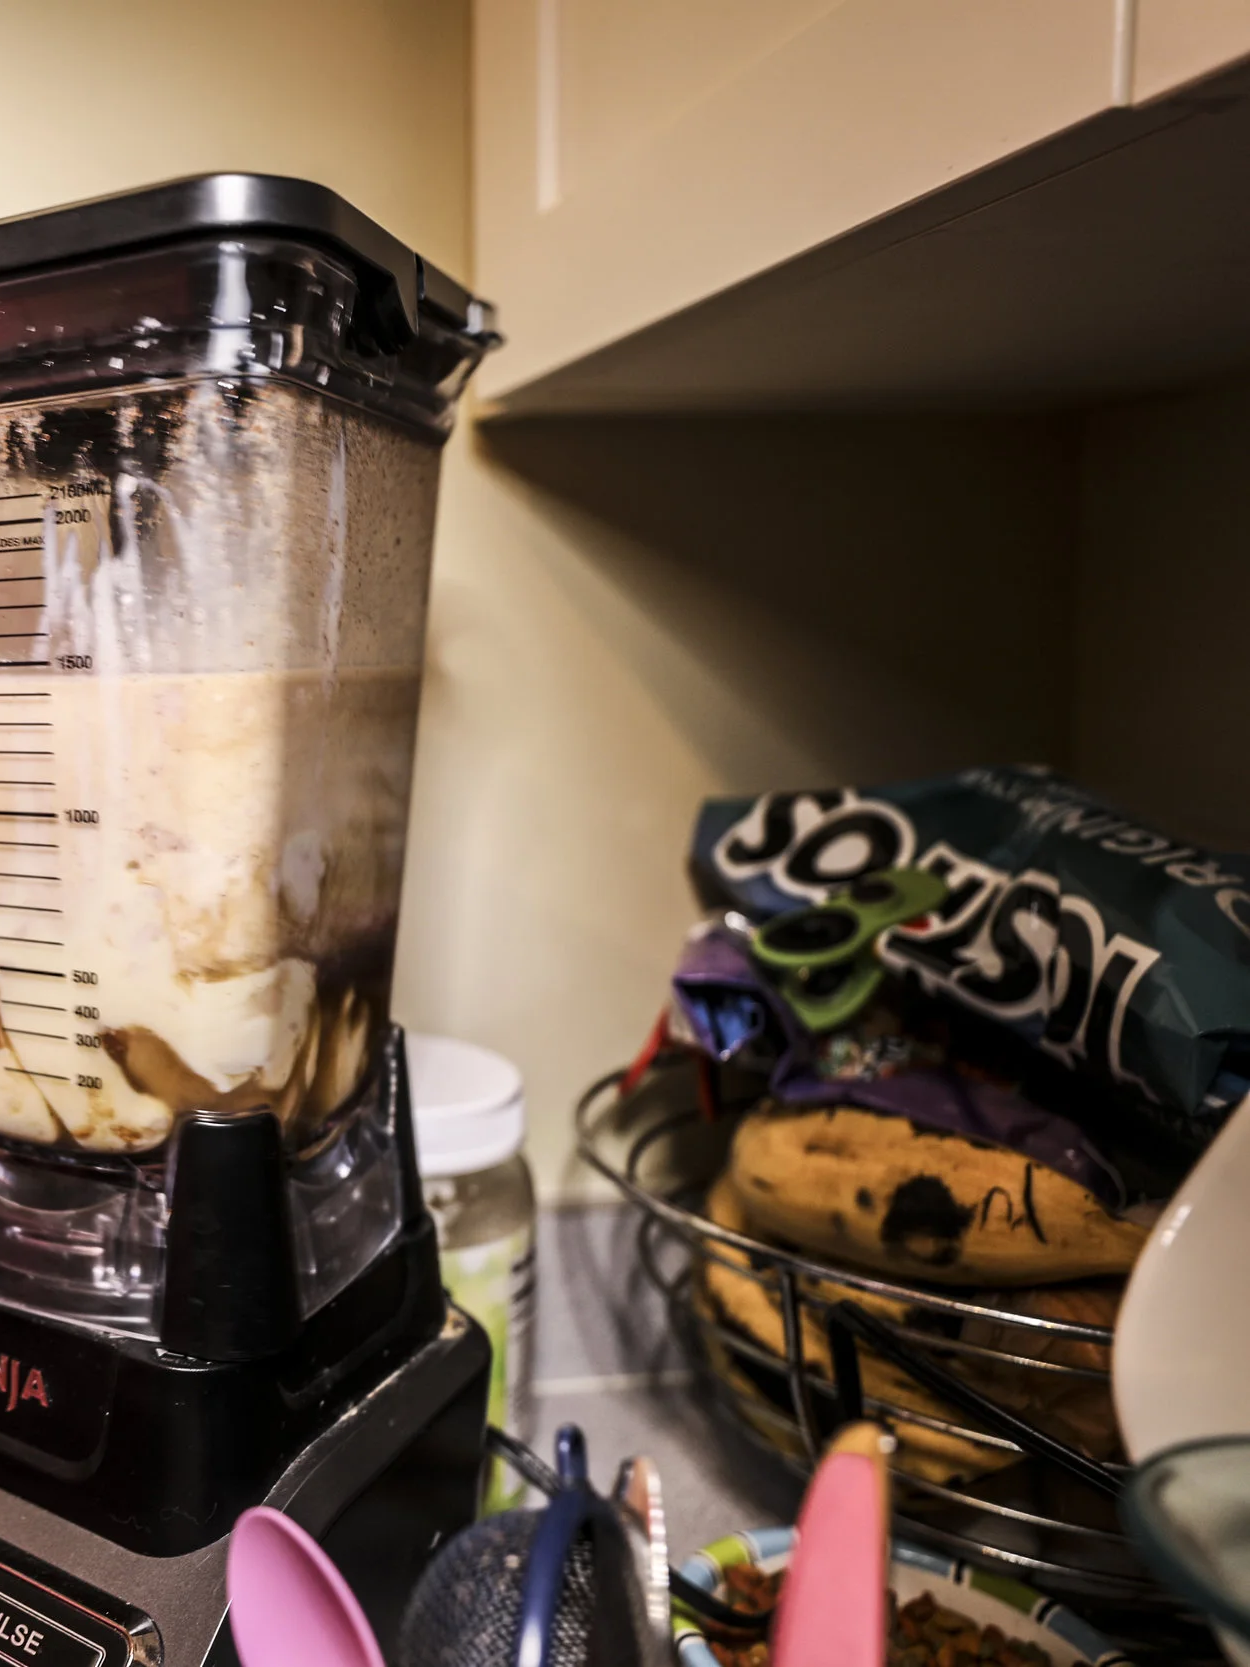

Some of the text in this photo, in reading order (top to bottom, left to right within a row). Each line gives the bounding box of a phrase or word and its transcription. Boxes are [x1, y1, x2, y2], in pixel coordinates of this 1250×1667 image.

[54, 509, 91, 524] 2000
[57, 655, 93, 670] 1500
[64, 809, 100, 824] 1000
[73, 970, 99, 985] 500
[75, 1006, 100, 1020] 400
[76, 1033, 101, 1049] 300
[77, 1074, 103, 1090] 200
